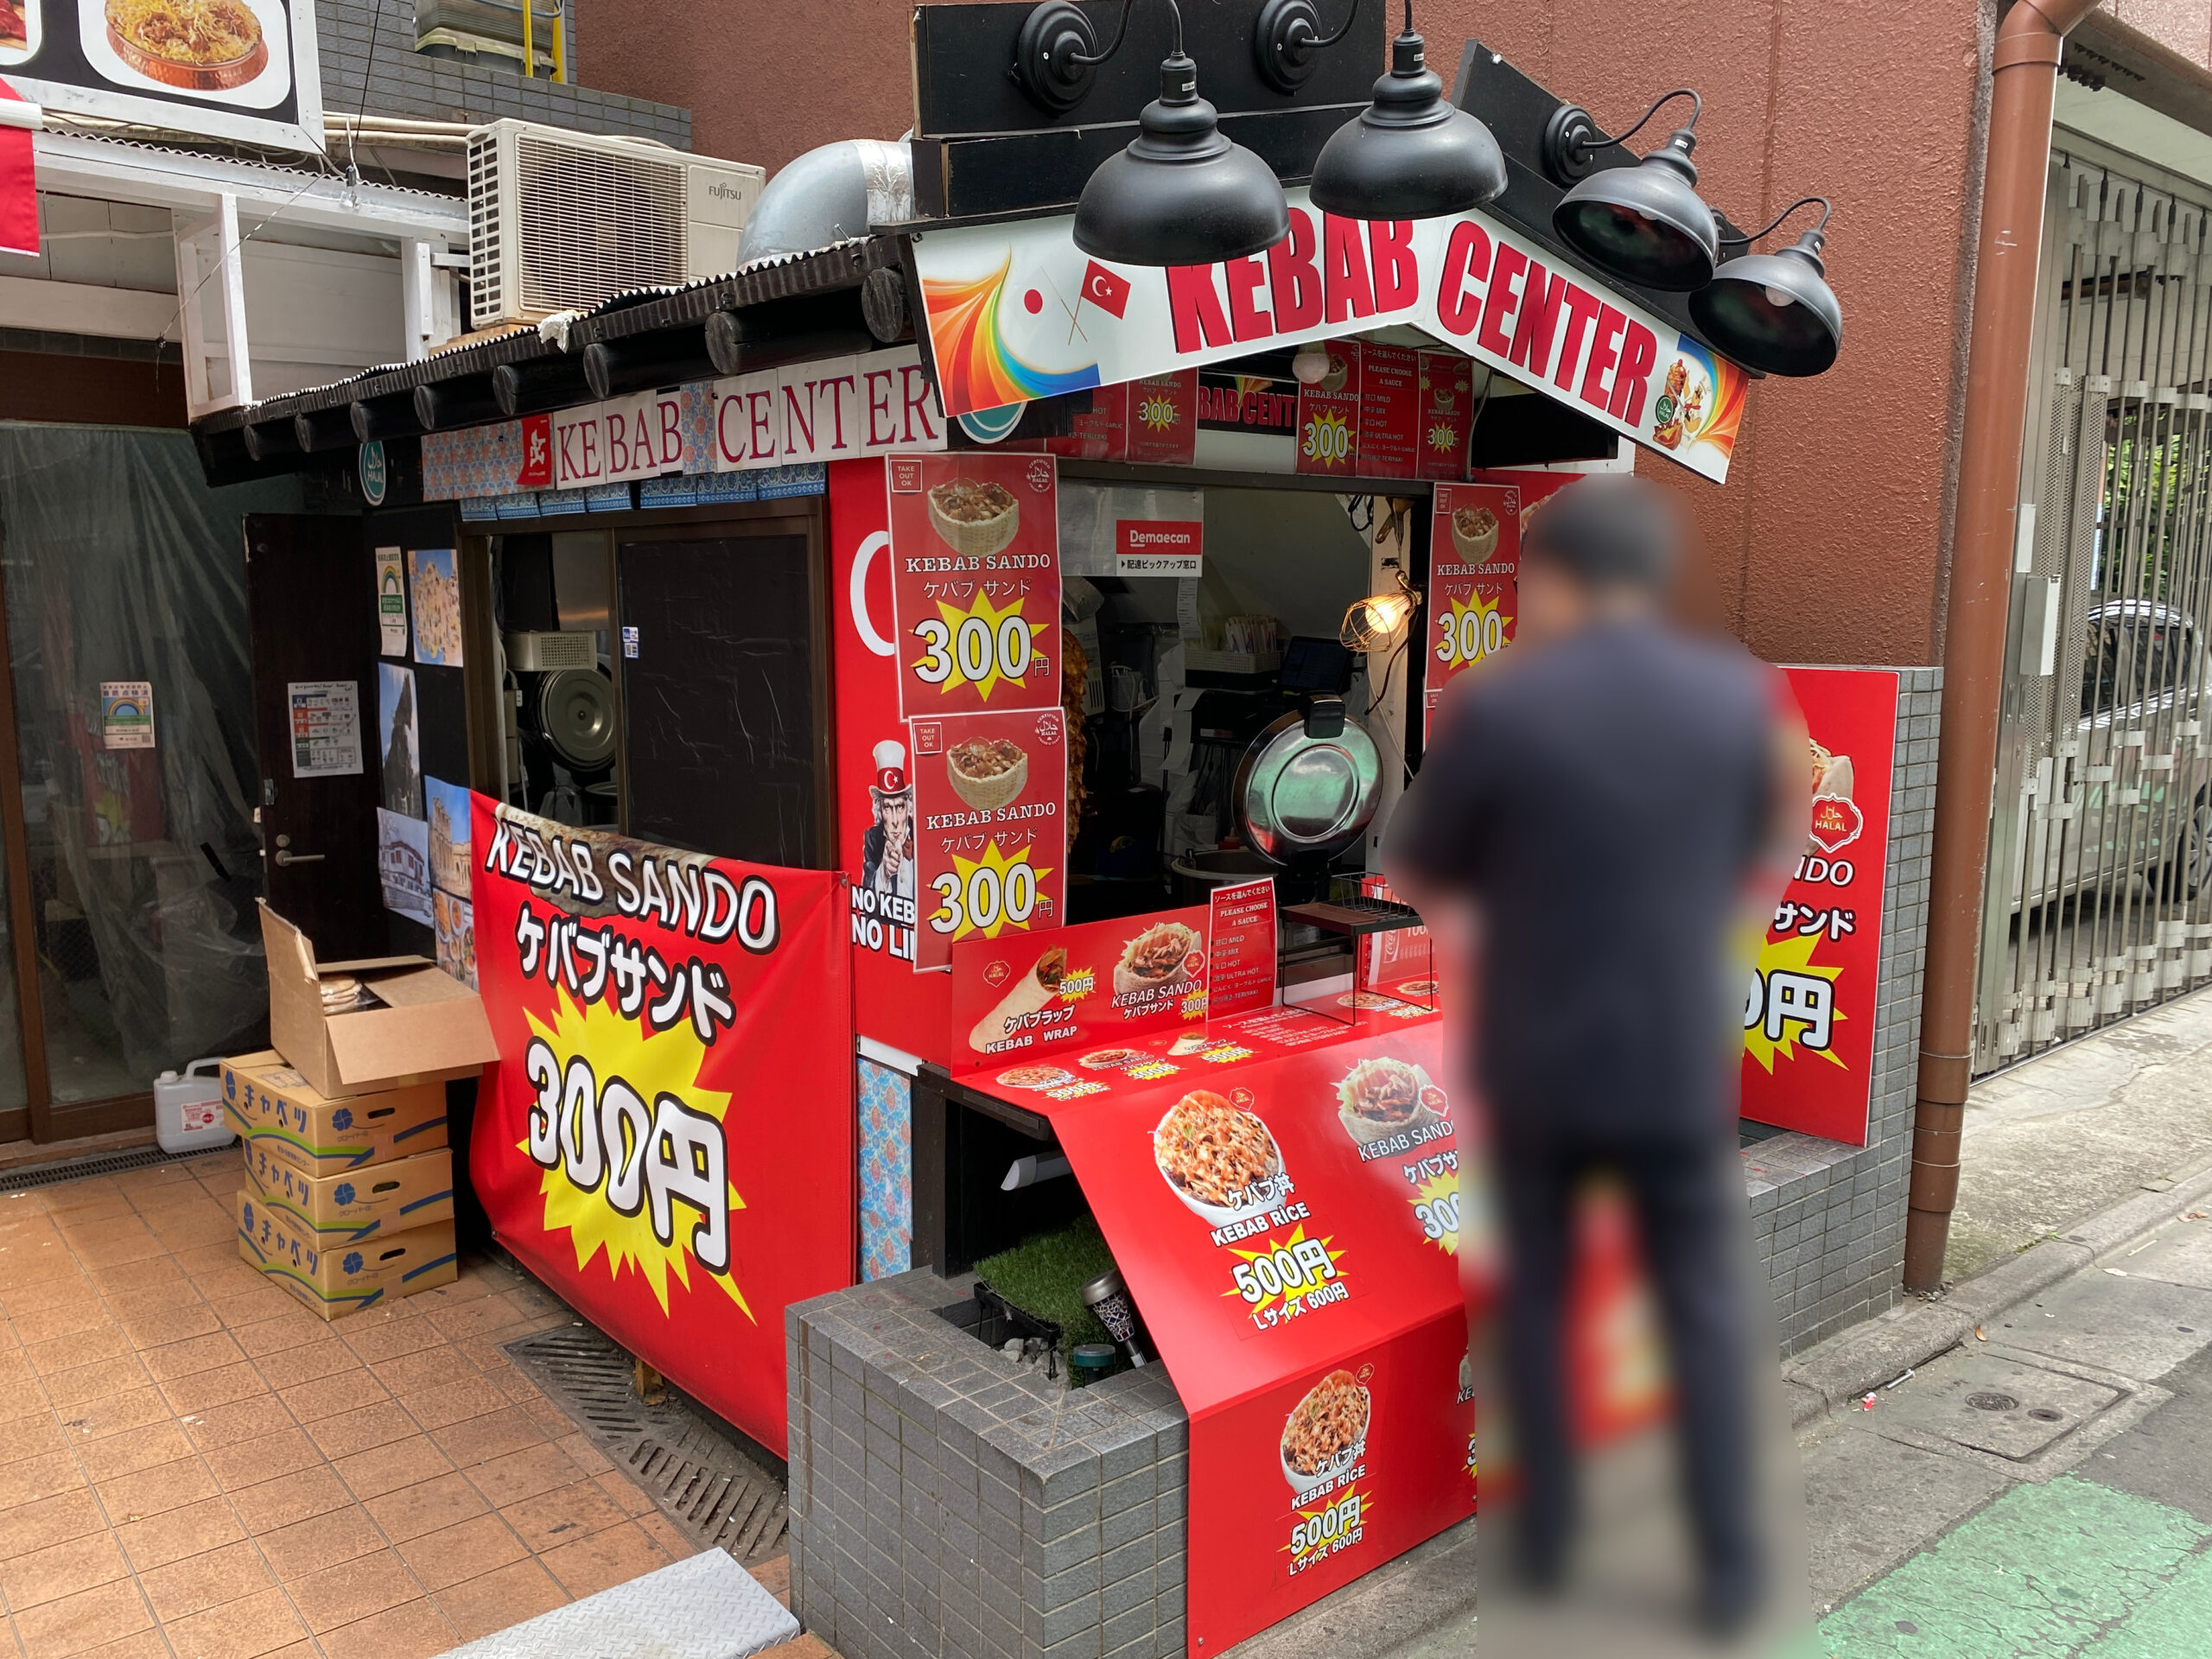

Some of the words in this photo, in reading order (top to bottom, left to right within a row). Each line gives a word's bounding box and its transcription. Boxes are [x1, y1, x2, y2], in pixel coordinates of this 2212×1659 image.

[709, 182, 741, 200] FUJITSU
[1166, 207, 1420, 354] KEBAB
[1437, 219, 1658, 429] CENTER
[1368, 365, 1390, 374] PLEASE
[1390, 367, 1413, 377] CHOOSE
[1384, 378, 1403, 387] SAUCE
[1243, 390, 1297, 428] CENT
[1304, 389, 1332, 399] KEBAB
[1332, 391, 1360, 402] SANDO
[560, 400, 683, 482] KEBAB
[717, 365, 940, 464] CENTER
[1129, 529, 1191, 545] Demaecan
[906, 555, 981, 573] KEBAB
[986, 553, 1051, 570] SANDO
[1437, 563, 1476, 575] KEBAB
[1478, 563, 1515, 575] SANDO
[923, 580, 975, 599] ケバブ
[982, 579, 1031, 597] サンド
[926, 810, 992, 830] KEBAB
[996, 802, 1056, 823] SANDO
[1815, 820, 1847, 832] HALAL
[1820, 804, 1842, 820] حلال
[941, 832, 987, 854] ケバブ
[994, 827, 1038, 848] サンド
[484, 815, 605, 905] KEBAB
[608, 851, 780, 953] SANDO
[1215, 886, 1270, 903] ソースを選んでください
[851, 884, 877, 913] NO
[1220, 906, 1244, 918] PLEASE
[1245, 902, 1268, 912] CHOOSE
[851, 912, 883, 950] NO
[1237, 915, 1258, 925] SAUCE
[1228, 935, 1244, 944] MILD
[517, 901, 735, 1046] ケバブサンド
[1227, 959, 1241, 968] HOT
[1227, 970, 1246, 979] ULTRA
[1059, 975, 1094, 995] 500円
[1111, 988, 1155, 1008] KEBAB
[1158, 979, 1202, 998] SANDO
[1235, 989, 1259, 999] TERIYAKI
[1003, 1005, 1076, 1033] ケバブラップ
[1123, 999, 1173, 1020] ケバブサンド
[986, 1034, 1033, 1055] KEBAB
[1043, 1025, 1077, 1042] WRAP
[245, 1084, 307, 1134] キャベツ
[526, 1036, 731, 1275] 300円
[1357, 1135, 1410, 1163] KEBAB
[258, 1152, 309, 1207] キャベツ
[1227, 1173, 1296, 1211] ケバブ丼
[1210, 1215, 1270, 1247] KEBAB
[263, 1219, 318, 1276] キャベツ
[1231, 1236, 1338, 1304] 500円
[1251, 1296, 1306, 1331] Lサイズ
[1306, 1281, 1350, 1309] 600円
[1315, 1440, 1366, 1478] ケバブ丼
[1291, 1480, 1333, 1511] KEBAB
[1290, 1495, 1362, 1556] 500円
[1288, 1548, 1329, 1577] Lサイズ
[1332, 1526, 1363, 1554] 600円
